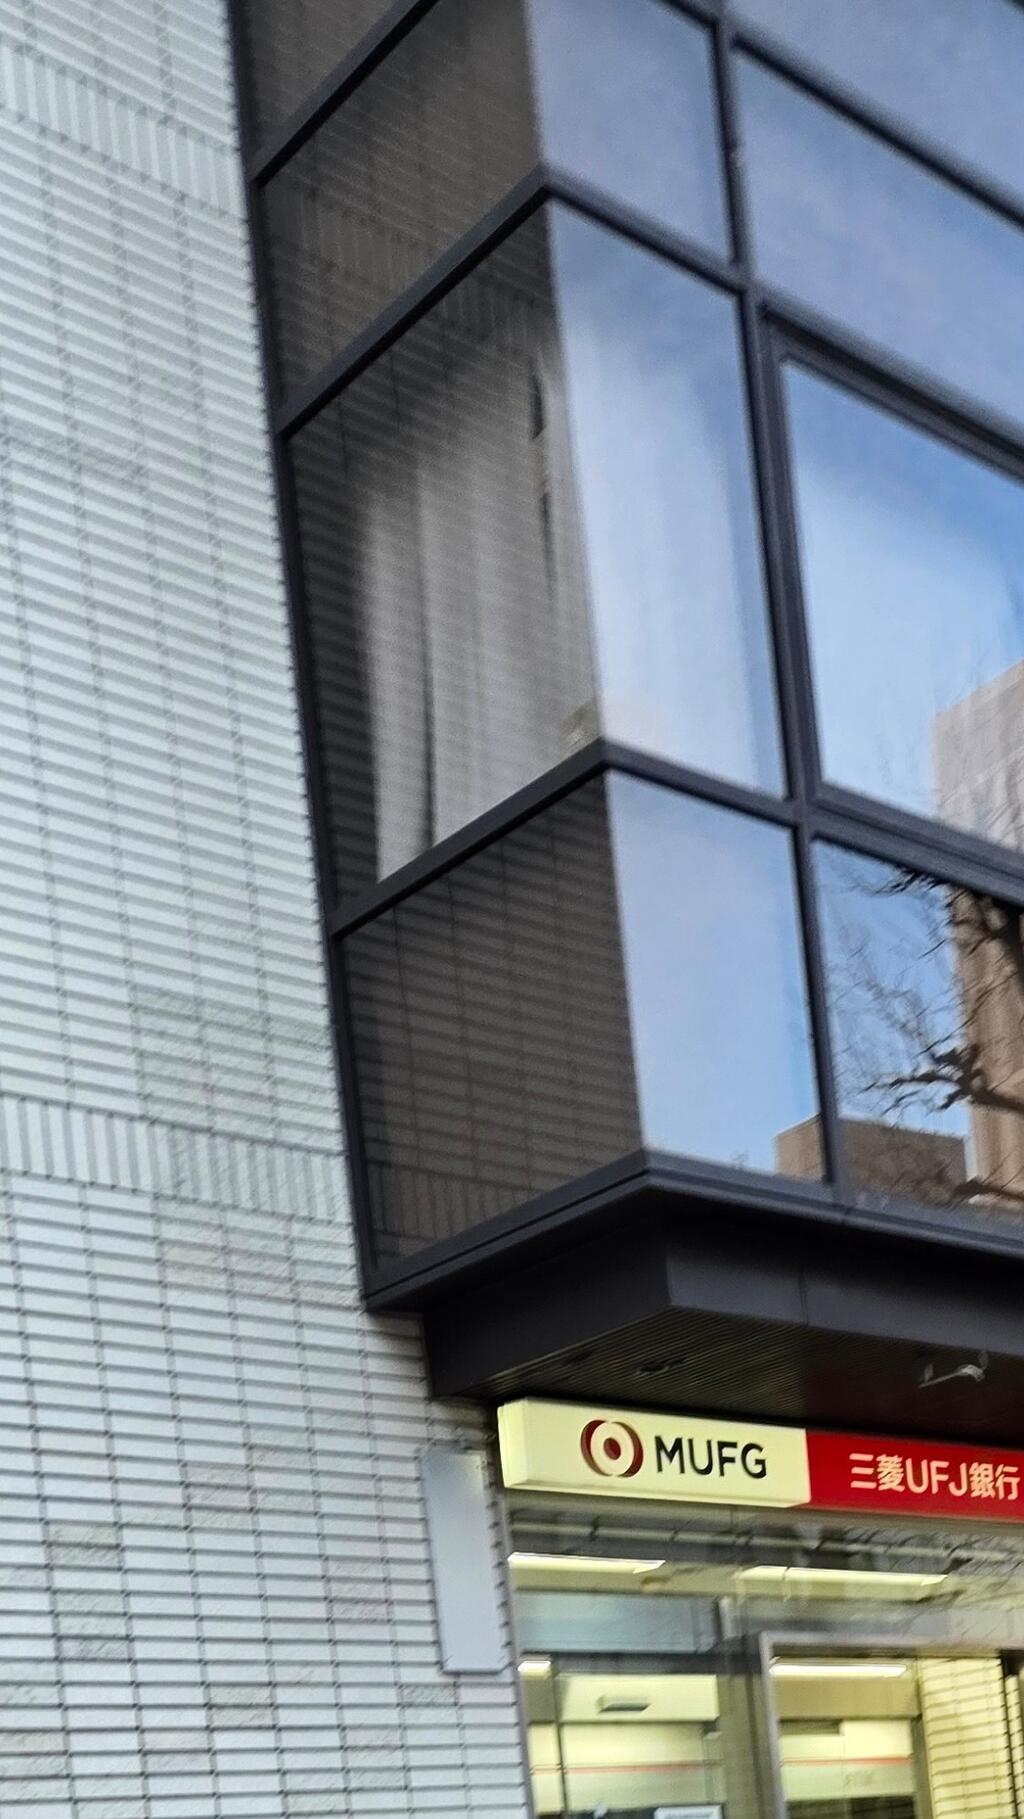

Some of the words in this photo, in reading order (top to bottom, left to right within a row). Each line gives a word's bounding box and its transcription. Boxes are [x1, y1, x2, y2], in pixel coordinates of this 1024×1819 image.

[654, 1436, 767, 1479] MUFG
[849, 1454, 1020, 1501] 三菱UFJ銀行
